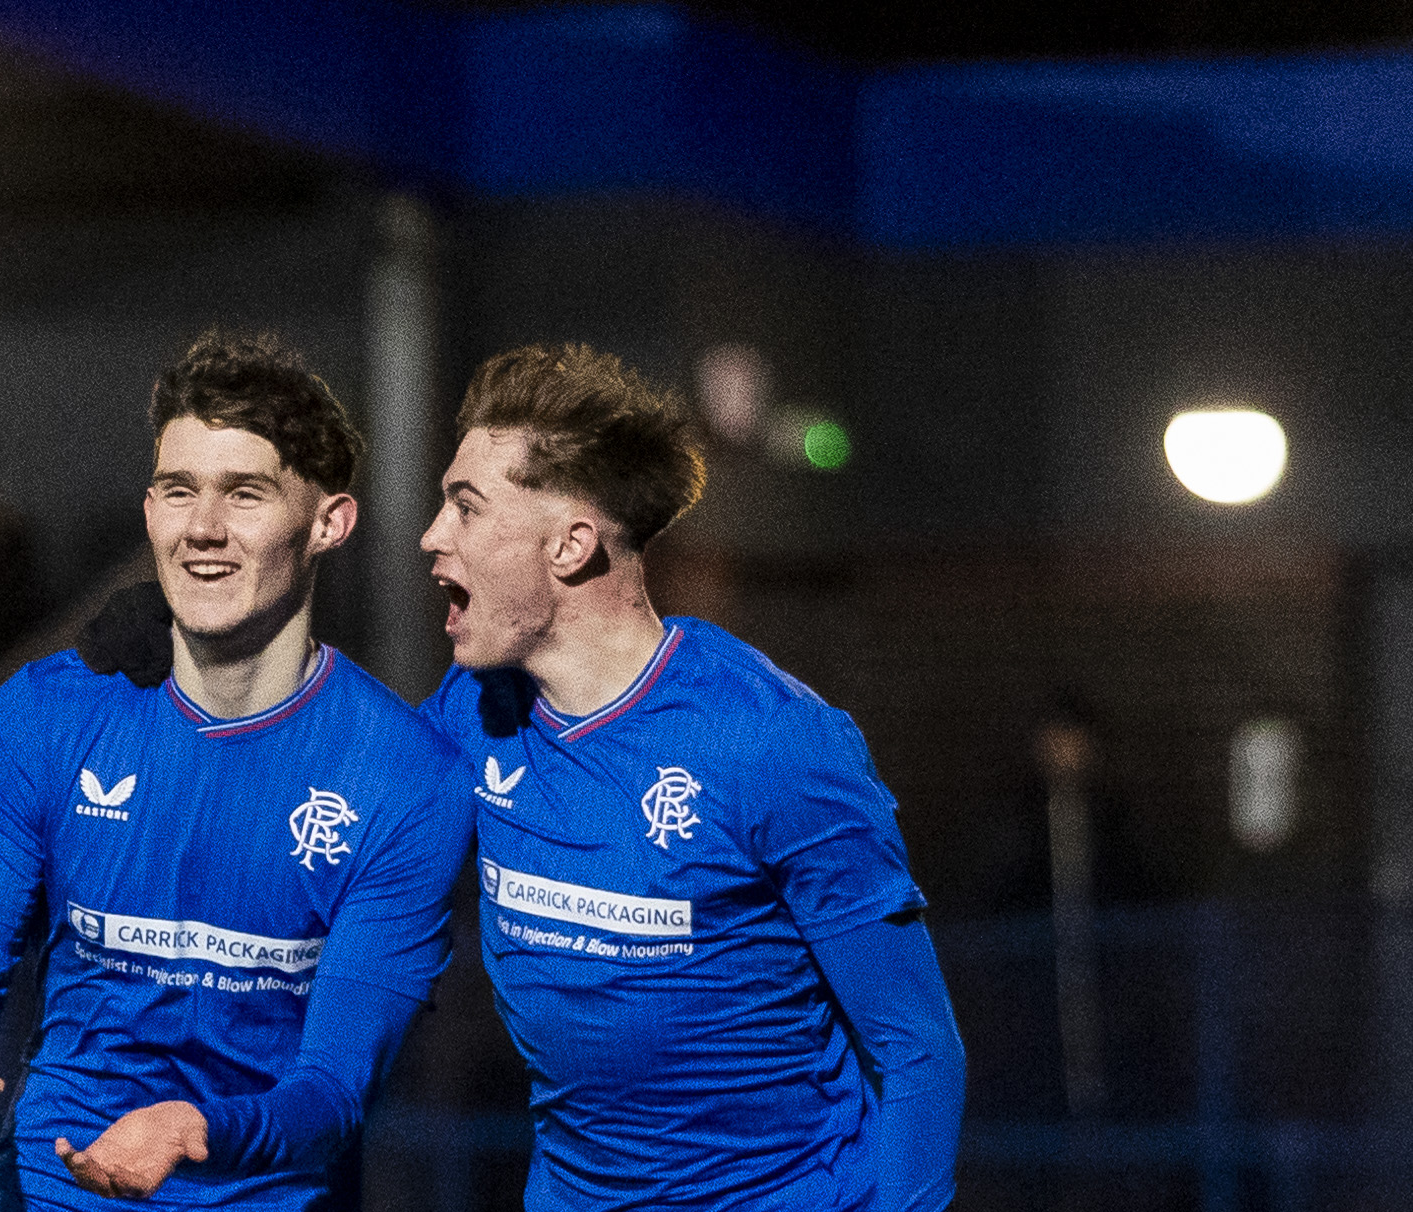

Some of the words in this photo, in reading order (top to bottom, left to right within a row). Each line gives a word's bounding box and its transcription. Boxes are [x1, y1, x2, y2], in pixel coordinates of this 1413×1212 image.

[506, 880, 572, 913] CARRICK
[577, 897, 685, 927] PACKAGING
[118, 925, 199, 949] CARRICK
[206, 933, 321, 964] PACKAGING
[522, 924, 572, 949] Injection
[573, 935, 586, 951] &
[586, 938, 620, 958] Blow
[131, 961, 144, 975] in
[202, 971, 215, 988] &
[217, 974, 252, 993] Blow
